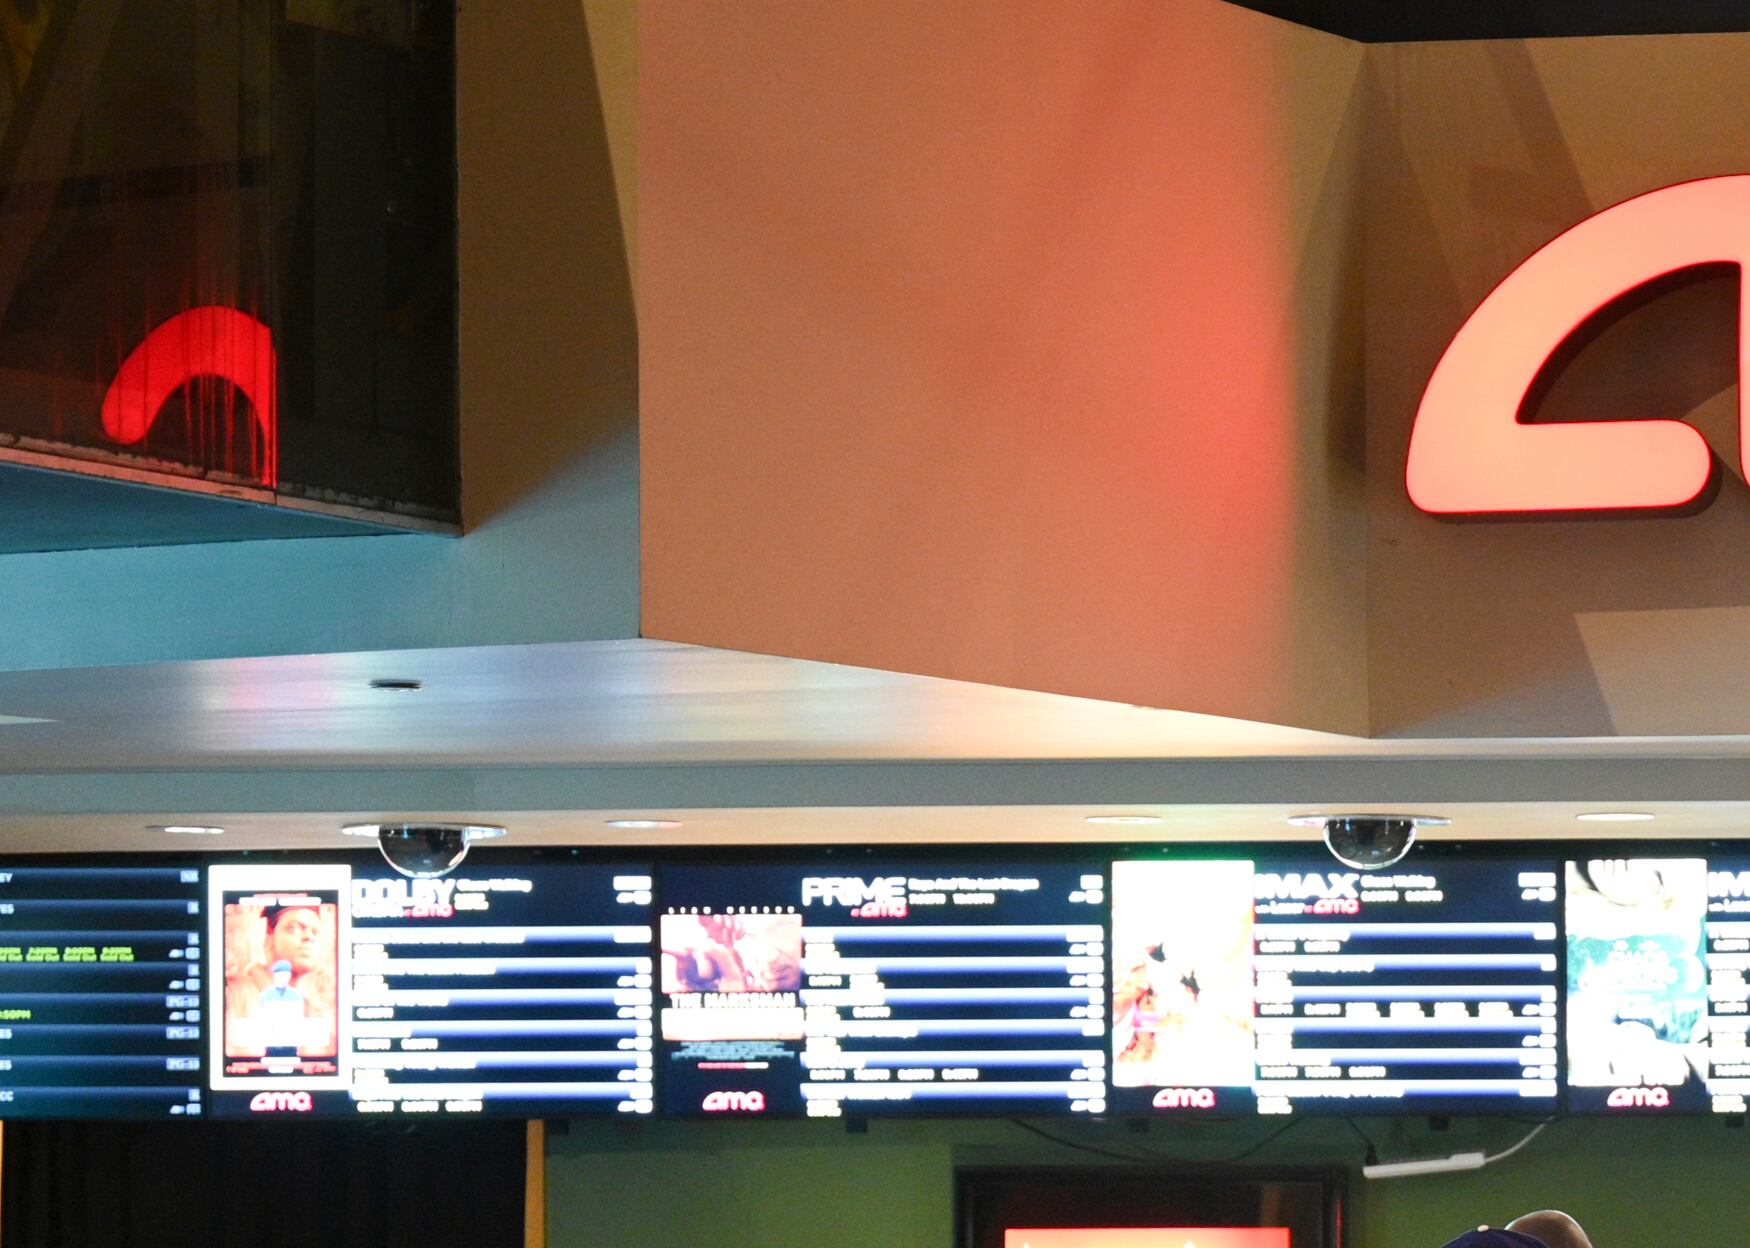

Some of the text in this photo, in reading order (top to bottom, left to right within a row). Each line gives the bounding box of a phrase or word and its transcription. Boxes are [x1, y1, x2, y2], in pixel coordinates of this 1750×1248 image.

[352, 878, 455, 906] DOLBY
[802, 877, 906, 906] PRIME
[860, 904, 908, 918] amc
[250, 1091, 312, 1111] amc
[703, 1091, 764, 1111] amc
[1153, 1088, 1215, 1108] amc
[1607, 1087, 1670, 1107] amc
